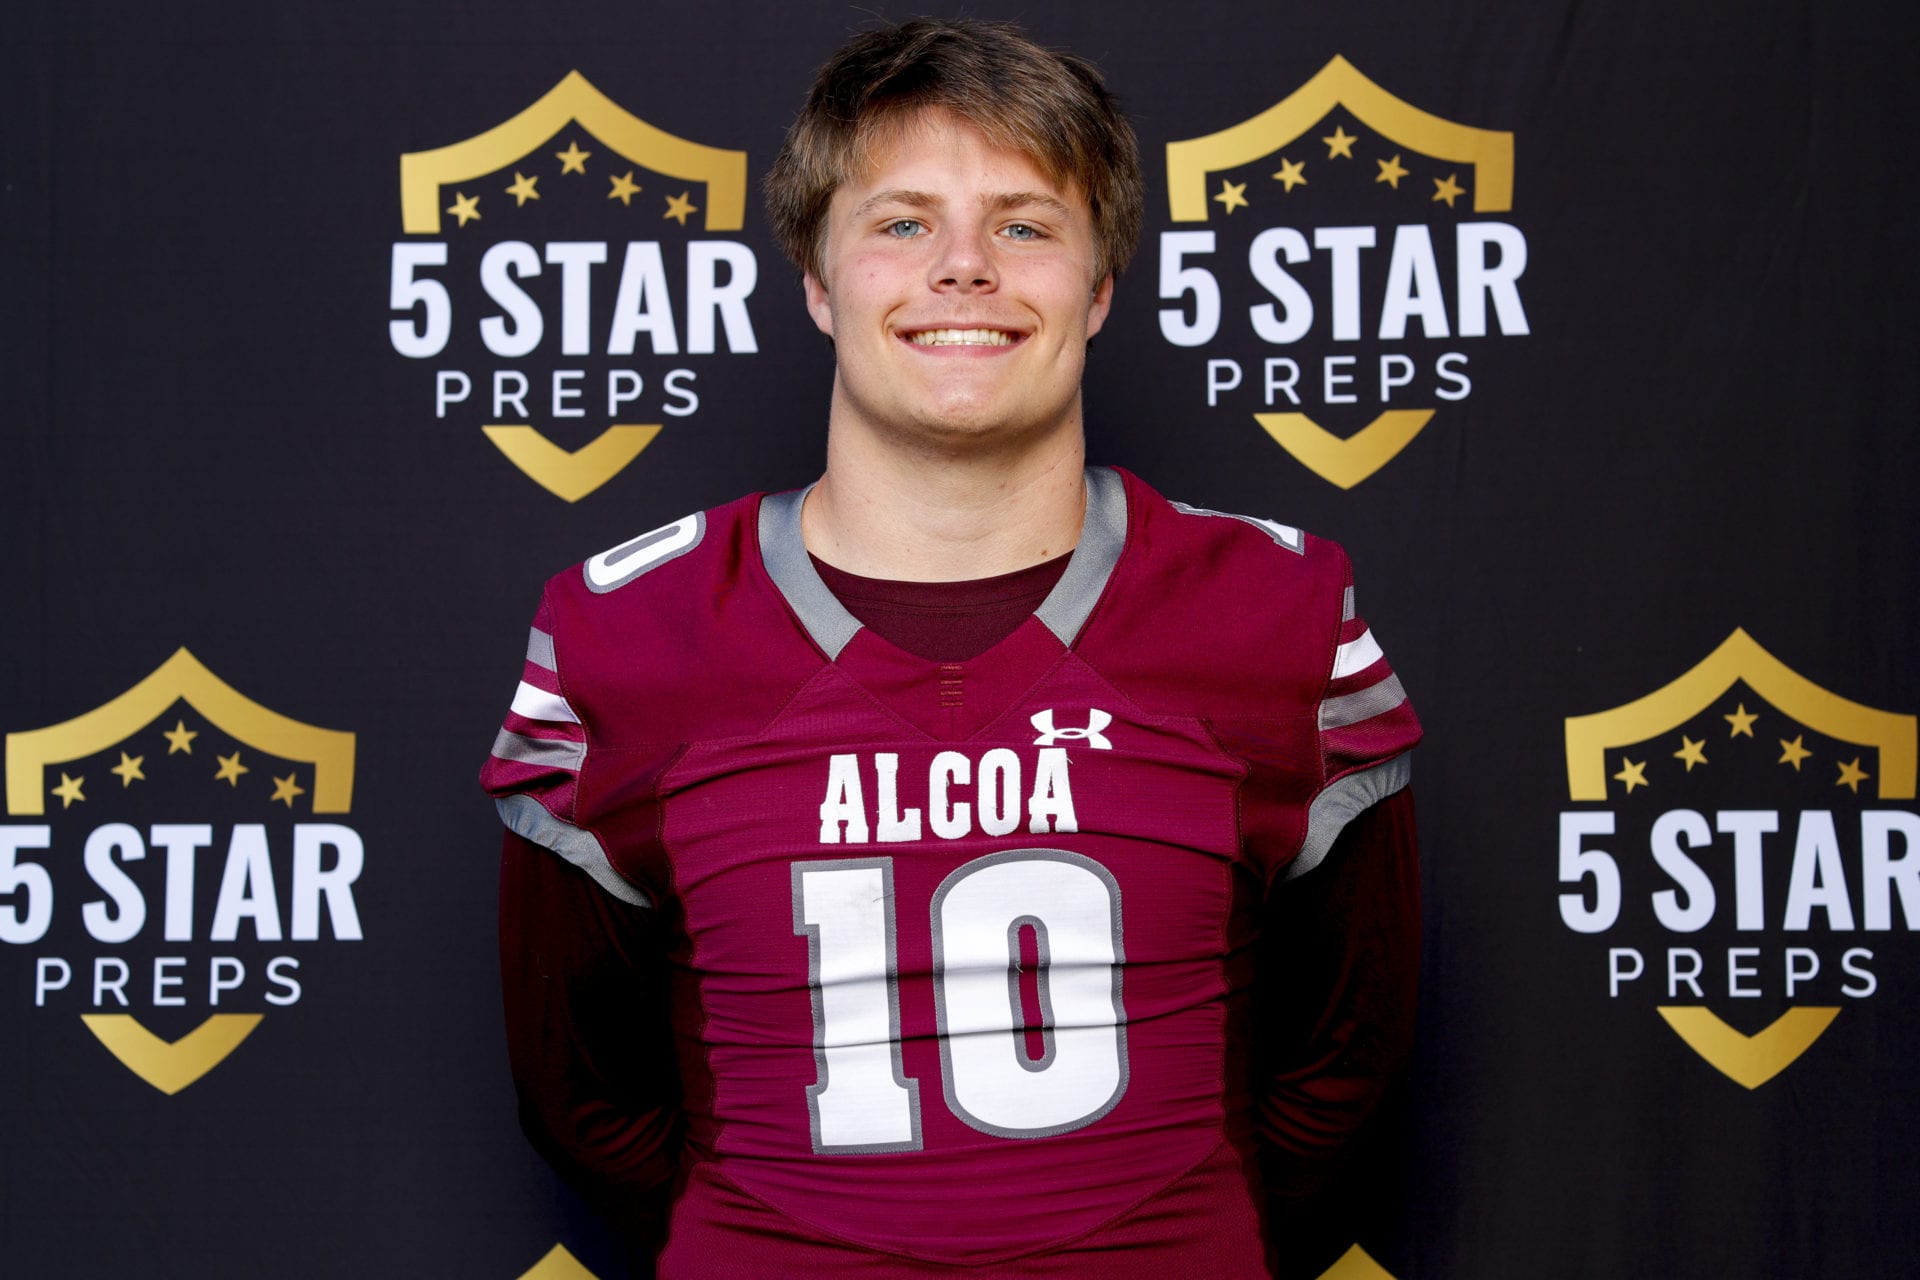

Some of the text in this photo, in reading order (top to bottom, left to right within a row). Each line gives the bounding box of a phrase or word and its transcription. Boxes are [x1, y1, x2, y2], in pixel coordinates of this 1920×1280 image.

[389, 240, 759, 359] 5 STAR
[1158, 221, 1530, 347] 5 STAR
[436, 368, 699, 418] PREPS
[1207, 352, 1471, 407] PREPS
[819, 747, 1079, 845] ALCOA
[0, 822, 365, 944] 5 STAR
[1558, 809, 1920, 934] 5 STAR
[35, 956, 302, 1007] PREPS
[791, 848, 1130, 1155] 10
[1608, 947, 1878, 998] PREPS
